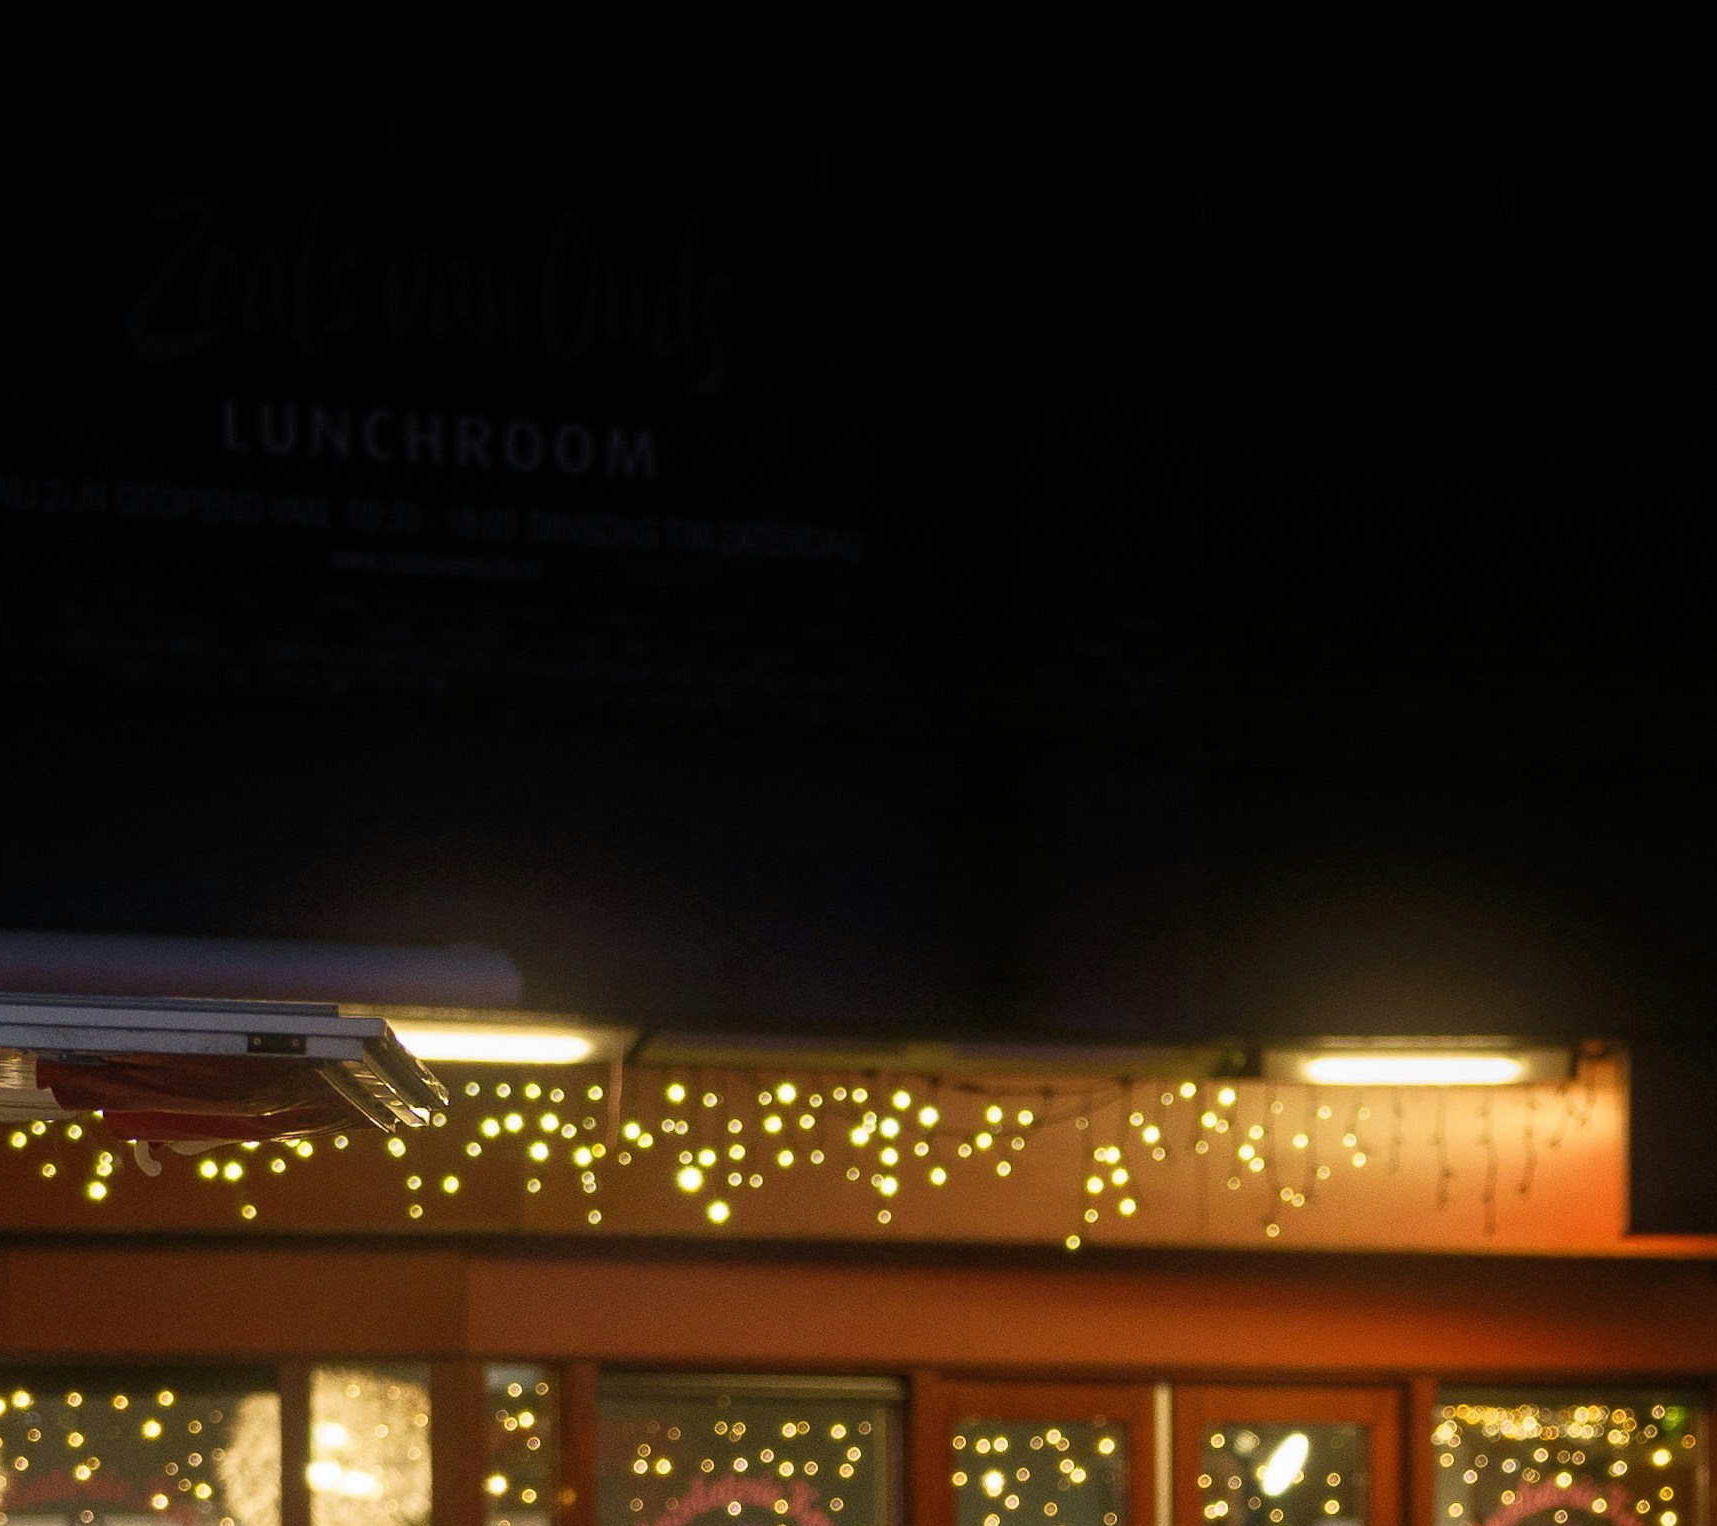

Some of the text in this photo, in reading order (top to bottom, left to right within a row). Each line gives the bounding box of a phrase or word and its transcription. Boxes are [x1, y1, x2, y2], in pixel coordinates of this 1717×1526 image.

[124, 193, 737, 398] Zoals van Ouds
[221, 397, 658, 482] LUNCHROOM
